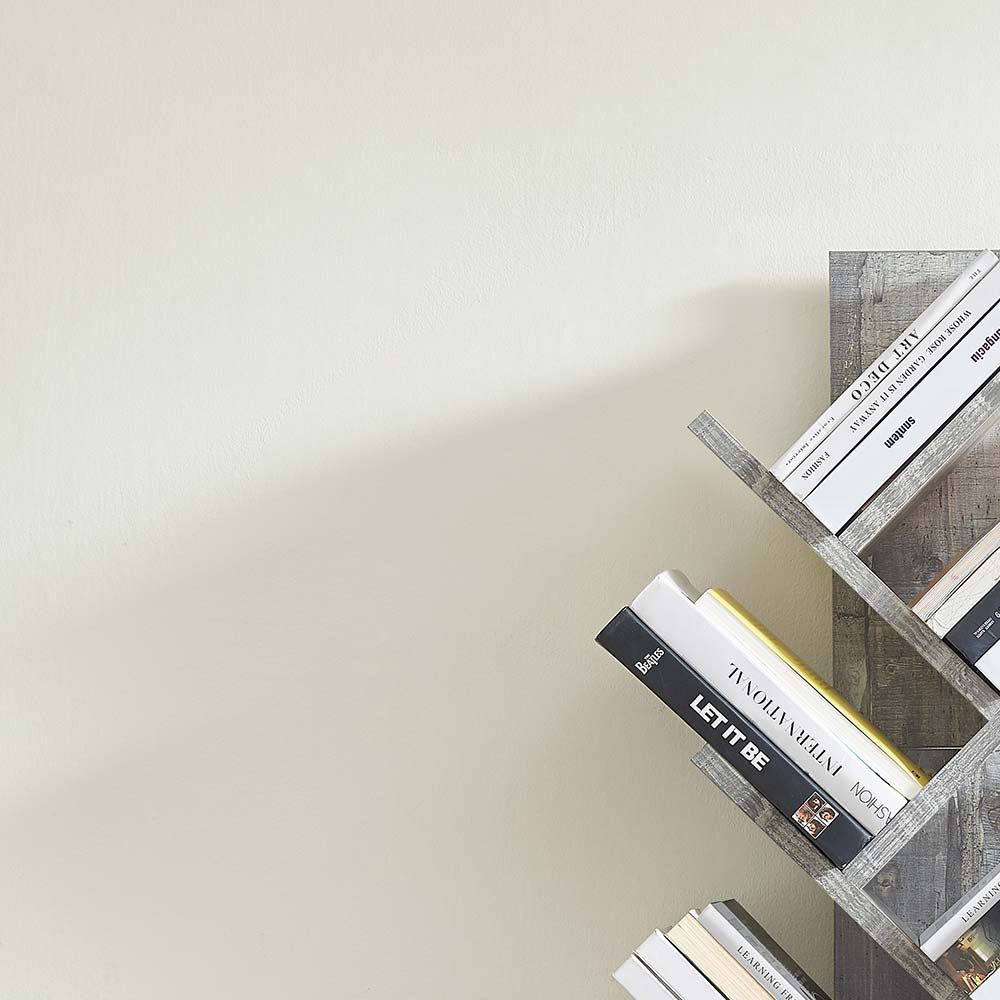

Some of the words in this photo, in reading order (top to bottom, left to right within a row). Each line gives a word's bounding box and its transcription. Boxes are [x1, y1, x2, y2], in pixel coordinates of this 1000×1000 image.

[944, 309, 973, 335] WHOSE
[892, 328, 920, 361] ART
[927, 333, 947, 356] ROSE
[850, 360, 890, 401] DECO
[895, 355, 926, 384] GARDEN
[879, 391, 890, 402] IT
[887, 383, 898, 395] IS
[849, 399, 880, 433] ANYWAY
[883, 416, 917, 449] snntem
[800, 451, 831, 479] FASHION
[689, 693, 730, 730] LET
[721, 723, 747, 747] IT
[739, 740, 771, 772] BE
[727, 662, 843, 777] INTERNATIONAL
[735, 944, 783, 991] LEARNING
